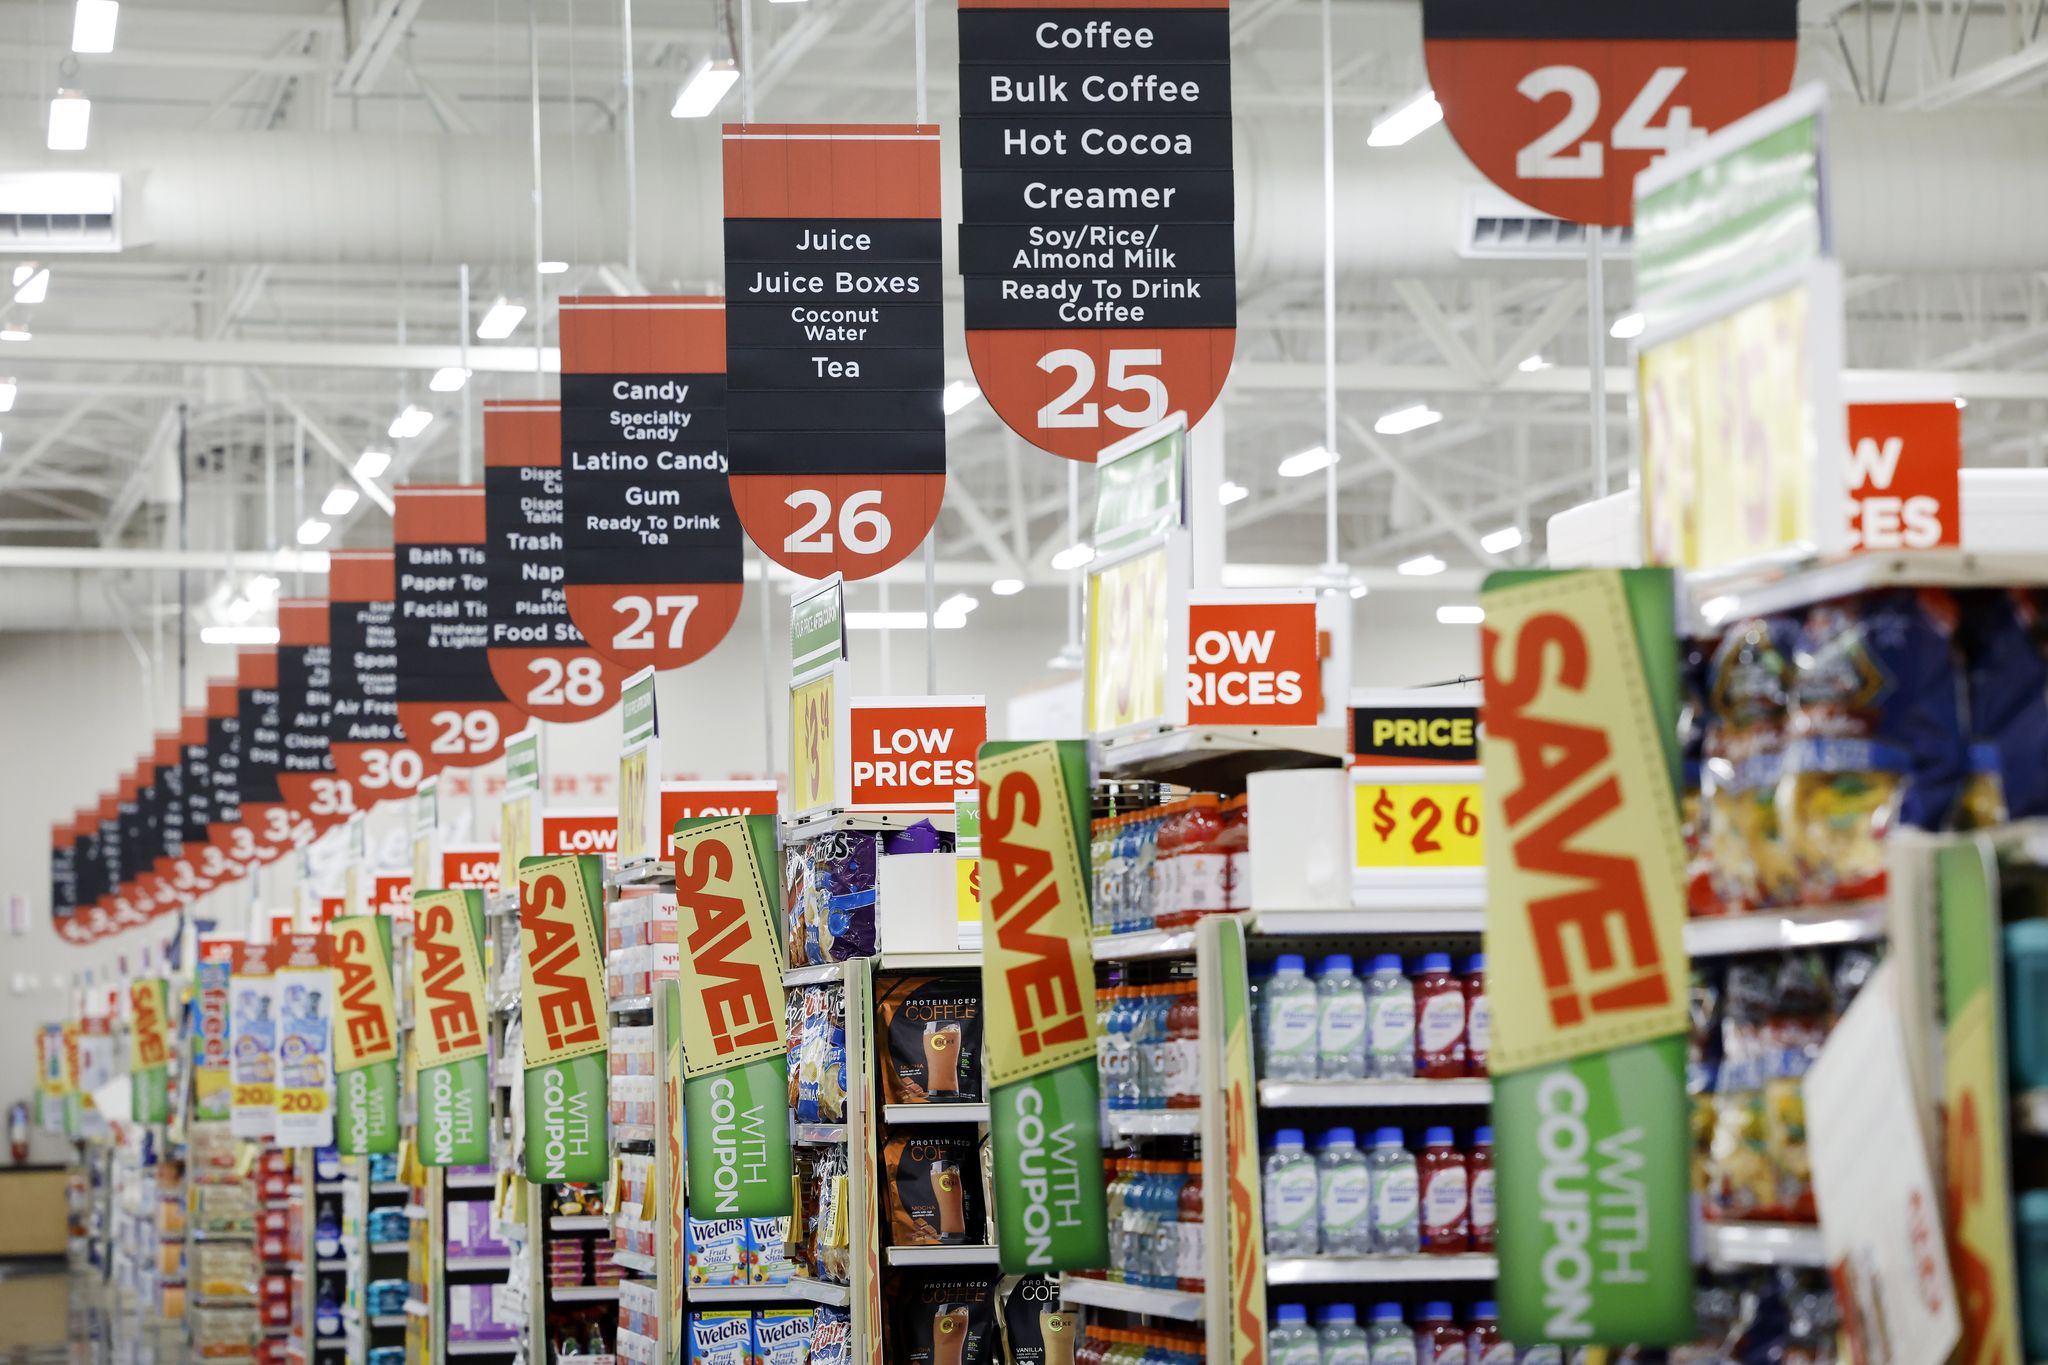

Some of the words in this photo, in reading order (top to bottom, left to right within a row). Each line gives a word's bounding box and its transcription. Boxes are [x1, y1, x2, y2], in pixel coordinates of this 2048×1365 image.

[1035, 21, 1154, 49] Coffee
[990, 75, 1068, 102] Bulk
[1081, 75, 1200, 102] Coffee
[1516, 64, 1708, 178] 24
[1003, 128, 1067, 155] Hot
[1081, 128, 1192, 155] Cocoa
[1023, 182, 1176, 209] Creamer
[796, 229, 871, 251] Juice
[1029, 225, 1158, 250] Soy/Rice/
[1012, 249, 1115, 270] Almond
[1124, 248, 1176, 268] Milk
[749, 272, 824, 294] Juice
[836, 272, 920, 294] Boxes
[1002, 279, 1083, 302] Ready
[1092, 280, 1122, 299] To
[1132, 278, 1200, 299] Drink
[791, 306, 879, 324] Coconut
[1058, 302, 1145, 322] Coffee
[804, 325, 867, 342] Water
[812, 356, 860, 378] Tea
[613, 381, 689, 403] Candy
[1036, 348, 1169, 429] 25
[610, 411, 691, 427] Specialty
[623, 426, 679, 441] Candy
[572, 452, 648, 471] Latino
[657, 452, 729, 473] Candy
[625, 487, 680, 506] Gum
[587, 516, 641, 532] Ready
[647, 516, 667, 530] To
[673, 515, 720, 530] Drink
[783, 488, 892, 555] 26
[506, 533, 563, 550] Trash
[639, 532, 669, 545] Tea
[409, 547, 453, 565] Bath
[401, 574, 456, 594] Paper
[522, 563, 564, 583] Nap
[403, 600, 459, 618] Facial
[516, 601, 567, 615] Plastic
[493, 623, 548, 642] Food
[612, 595, 699, 650] 27
[527, 657, 604, 706] 28
[431, 711, 498, 755] 29
[872, 729, 954, 755] LOW
[1373, 718, 1473, 747] PRICE
[359, 749, 423, 788] 30
[853, 760, 975, 787] PRICES
[310, 779, 353, 815] 31
[1481, 611, 1673, 1029] SAVE!
[559, 830, 617, 850] LOW
[980, 771, 1089, 1058] SAVE!
[676, 839, 779, 1056] SAVE!
[520, 874, 600, 1051] SAVE!
[414, 905, 482, 1055] SAVE!
[333, 930, 391, 1058] SAVE!
[905, 1005, 976, 1020] COFFEE
[351, 1071, 368, 1154] COUPON
[369, 1088, 386, 1137] WITH
[434, 1070, 453, 1163] COUPON
[455, 1088, 473, 1144] WITH
[544, 1069, 566, 1180] COUPON
[568, 1091, 589, 1157] WITH
[711, 1078, 739, 1213] COUPON
[741, 1105, 768, 1185] WITH
[1016, 1086, 1053, 1266] COUPON
[1050, 1122, 1082, 1228] WITH
[1537, 1071, 1594, 1340] COUPON
[1600, 1128, 1649, 1283] WITH
[703, 1255, 732, 1265] Snacks
[709, 1248, 728, 1257] Fruit
[1022, 1286, 1060, 1301] COF
[696, 1320, 747, 1346] Welch's
[759, 1319, 809, 1346] Welch's
[713, 1353, 732, 1361] Fruit
[775, 1351, 794, 1360] Fruit
